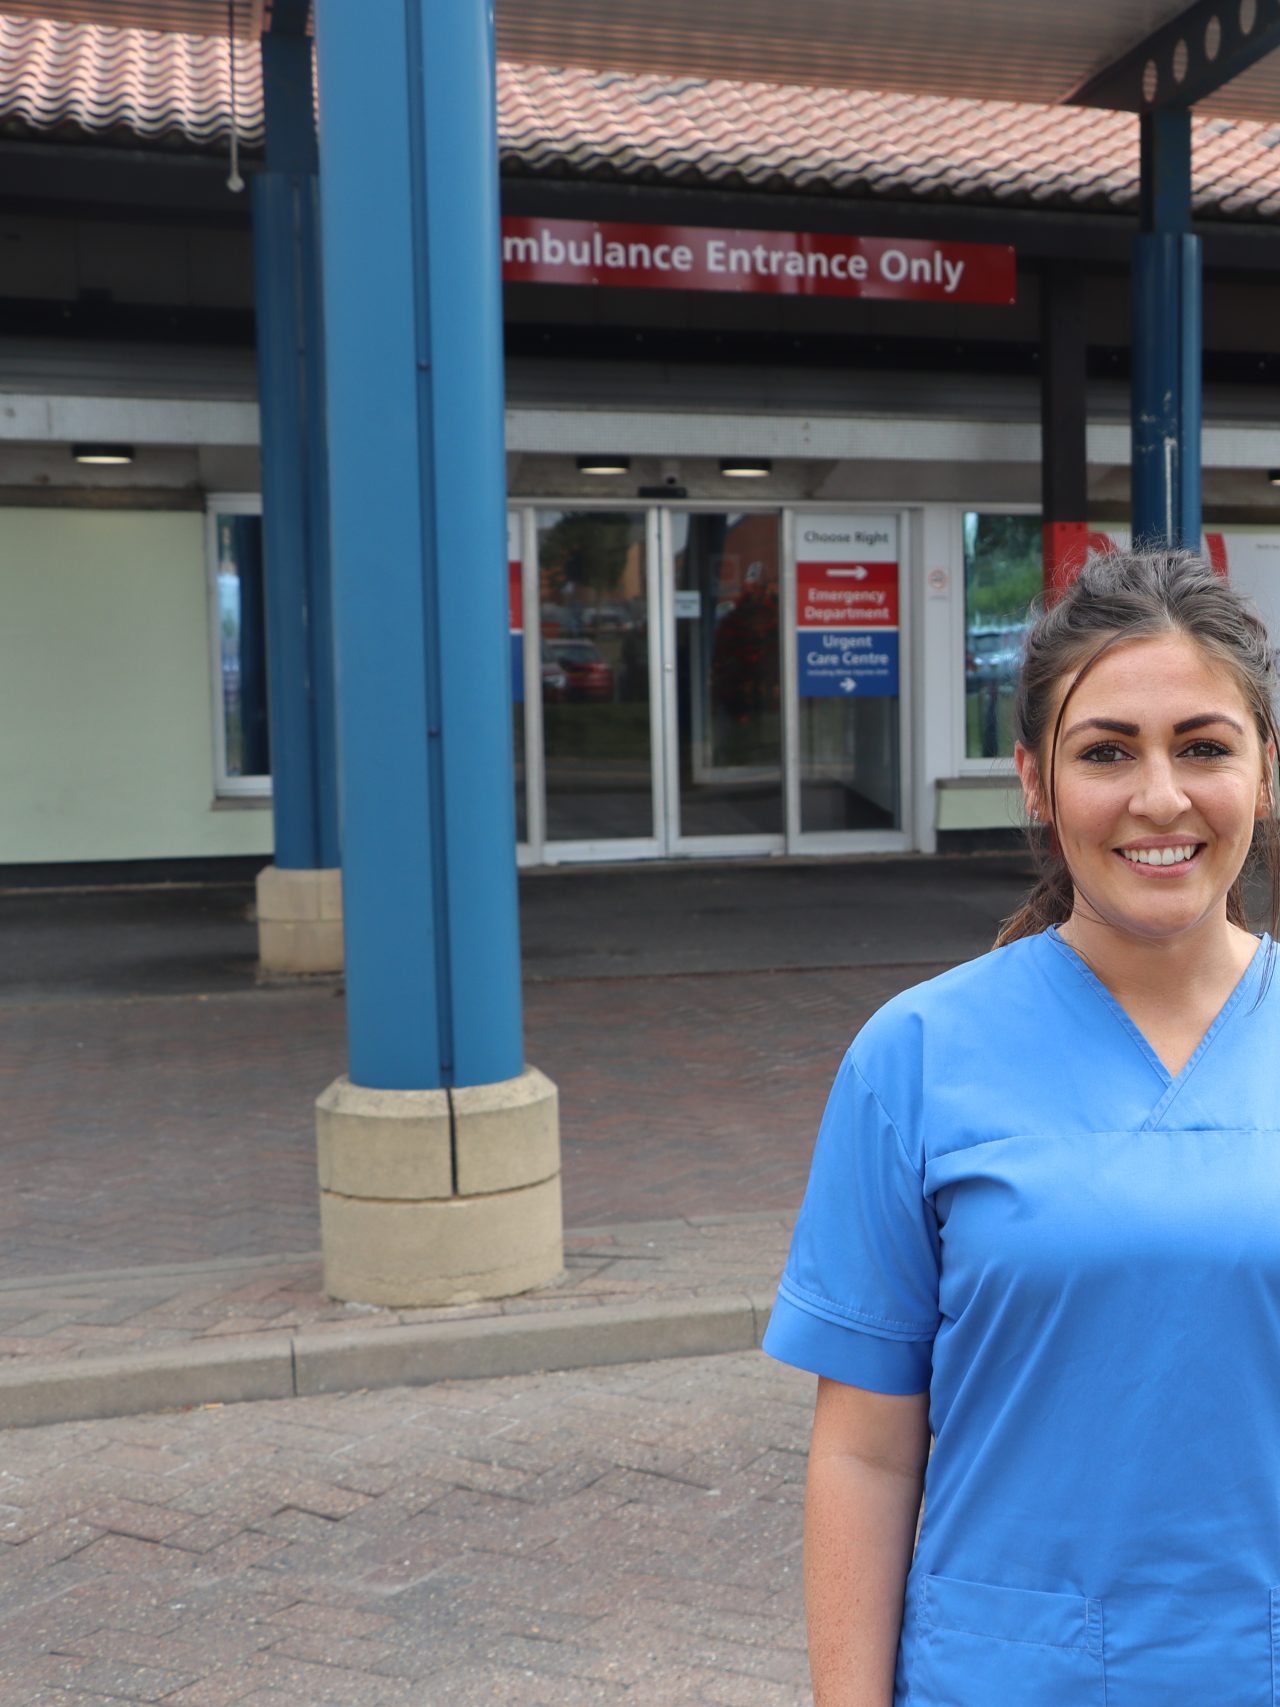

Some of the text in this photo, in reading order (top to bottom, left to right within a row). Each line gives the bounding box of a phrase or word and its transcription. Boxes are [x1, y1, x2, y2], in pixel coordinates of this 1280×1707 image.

[503, 228, 965, 292] mbulance Entrance Only
[803, 530, 889, 546] Choose Right
[808, 588, 887, 605] Emergency
[804, 606, 889, 622] Department
[823, 634, 873, 651] Urgent
[807, 652, 889, 666] Care Centre
